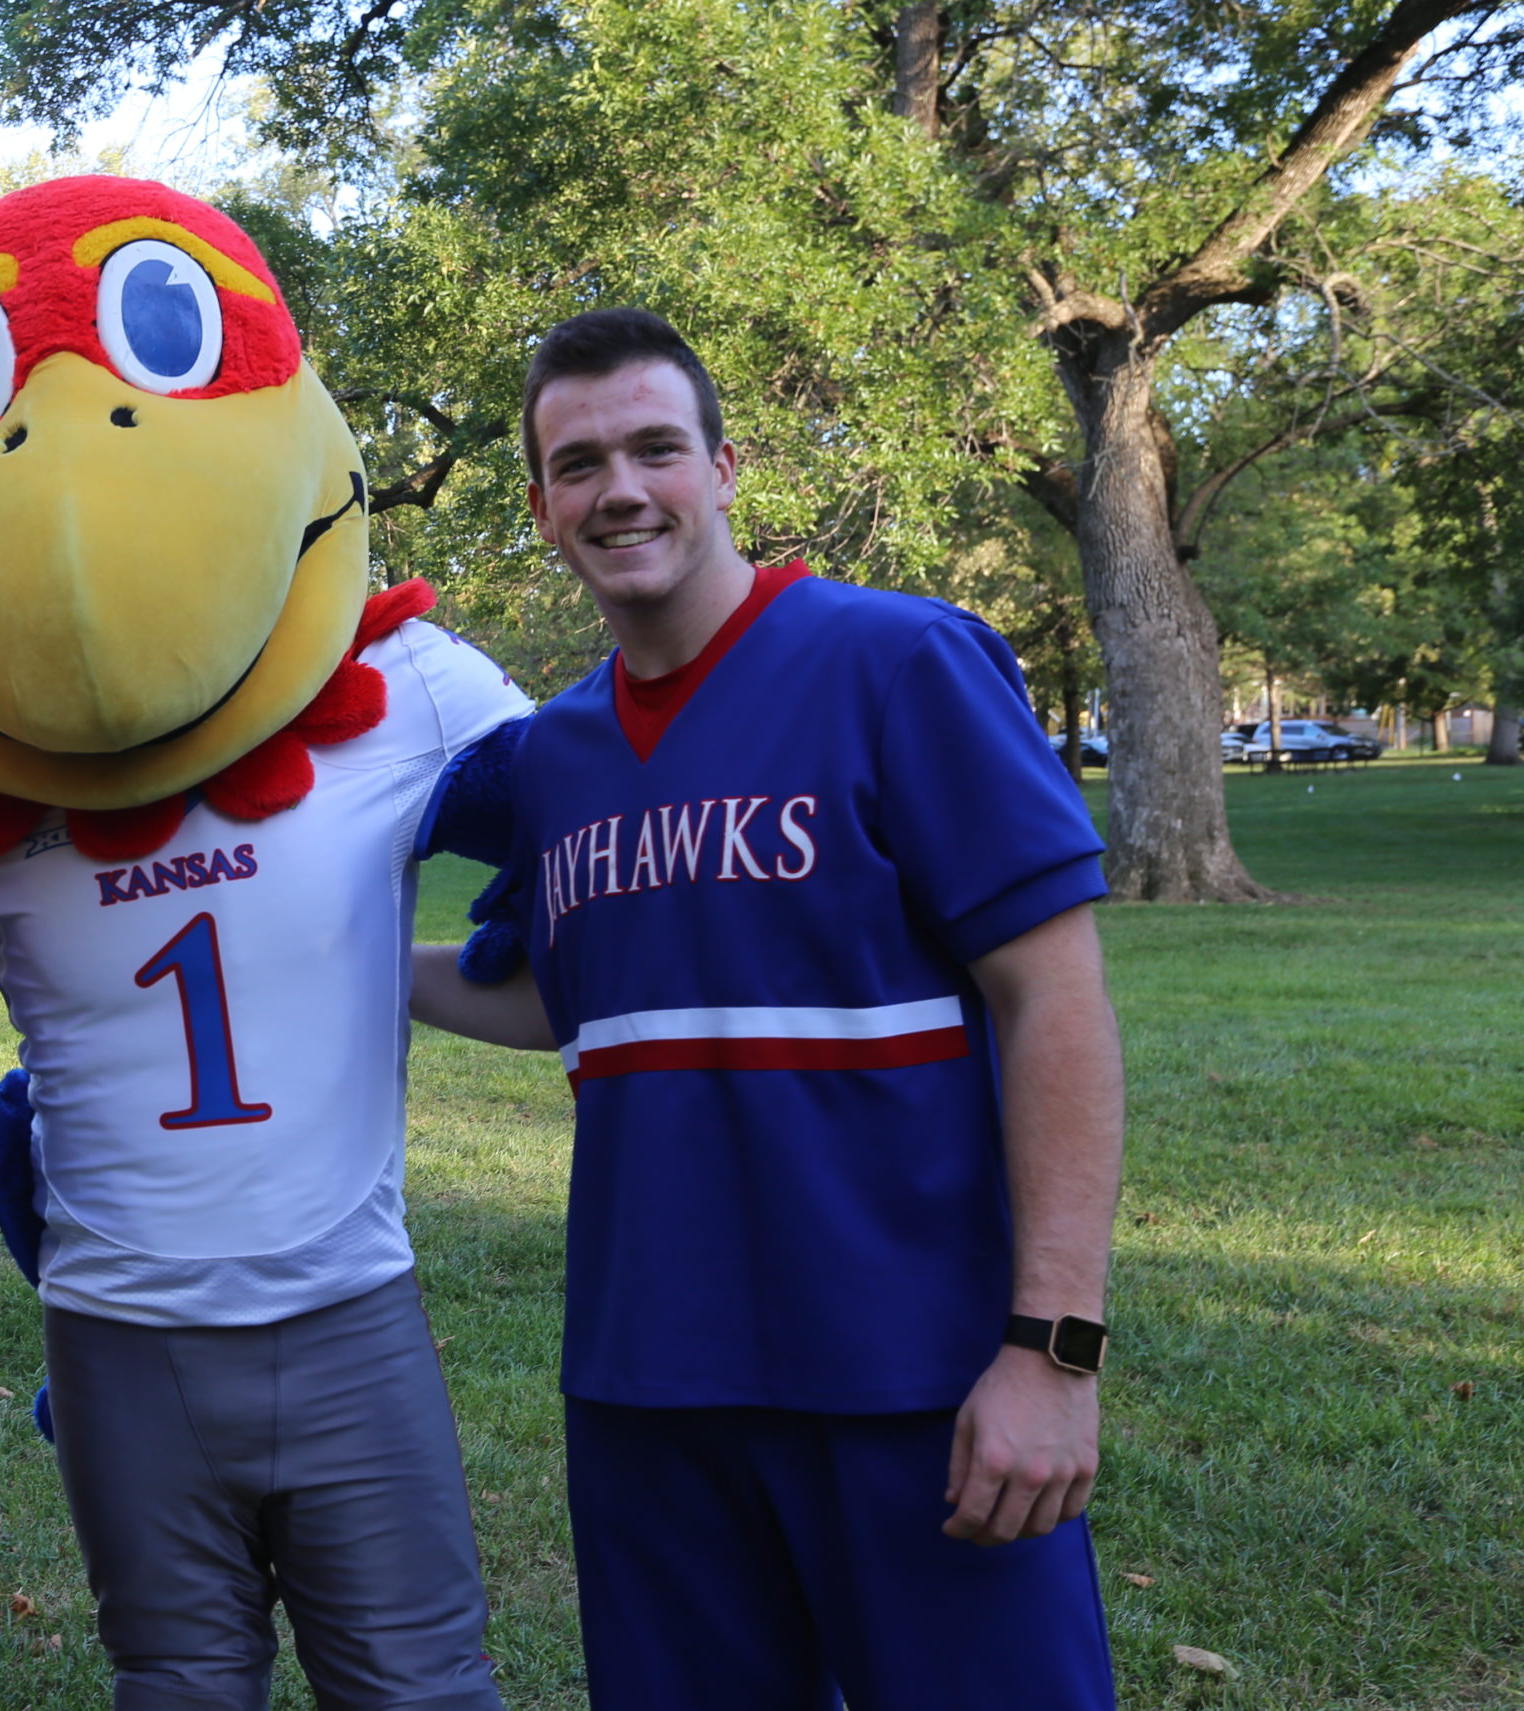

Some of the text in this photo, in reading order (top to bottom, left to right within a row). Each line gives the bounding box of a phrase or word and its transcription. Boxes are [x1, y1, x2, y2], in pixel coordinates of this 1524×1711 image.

[94, 844, 259, 907] KANSAS
[541, 794, 819, 950] JAYHAWKS
[134, 911, 273, 1131] 1
